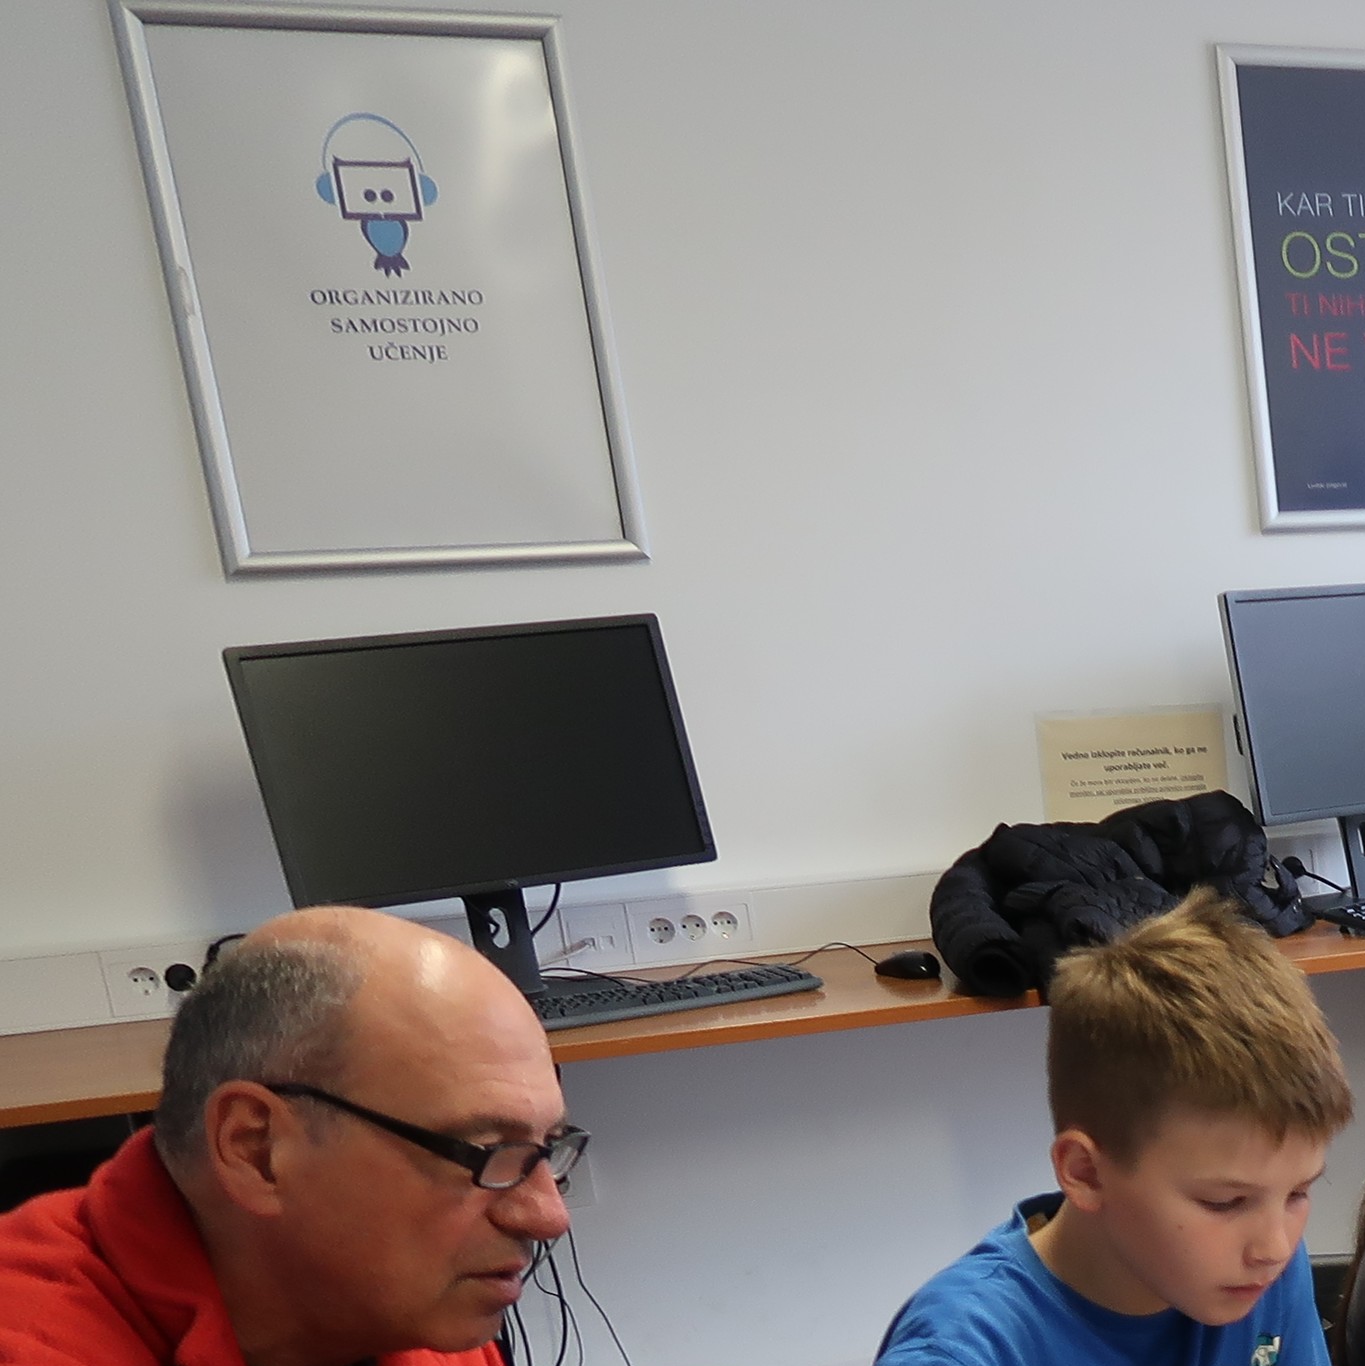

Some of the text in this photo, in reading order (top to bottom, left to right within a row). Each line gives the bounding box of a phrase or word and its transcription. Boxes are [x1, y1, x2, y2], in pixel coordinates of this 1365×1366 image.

[1277, 191, 1334, 217] KAR
[1342, 193, 1365, 217] TI
[310, 289, 484, 306] ORGANIZIRANO
[1286, 292, 1310, 317] TI
[330, 317, 480, 337] SAMOSTOJNO
[367, 341, 448, 364] UČENJE
[1290, 331, 1351, 371] NE
